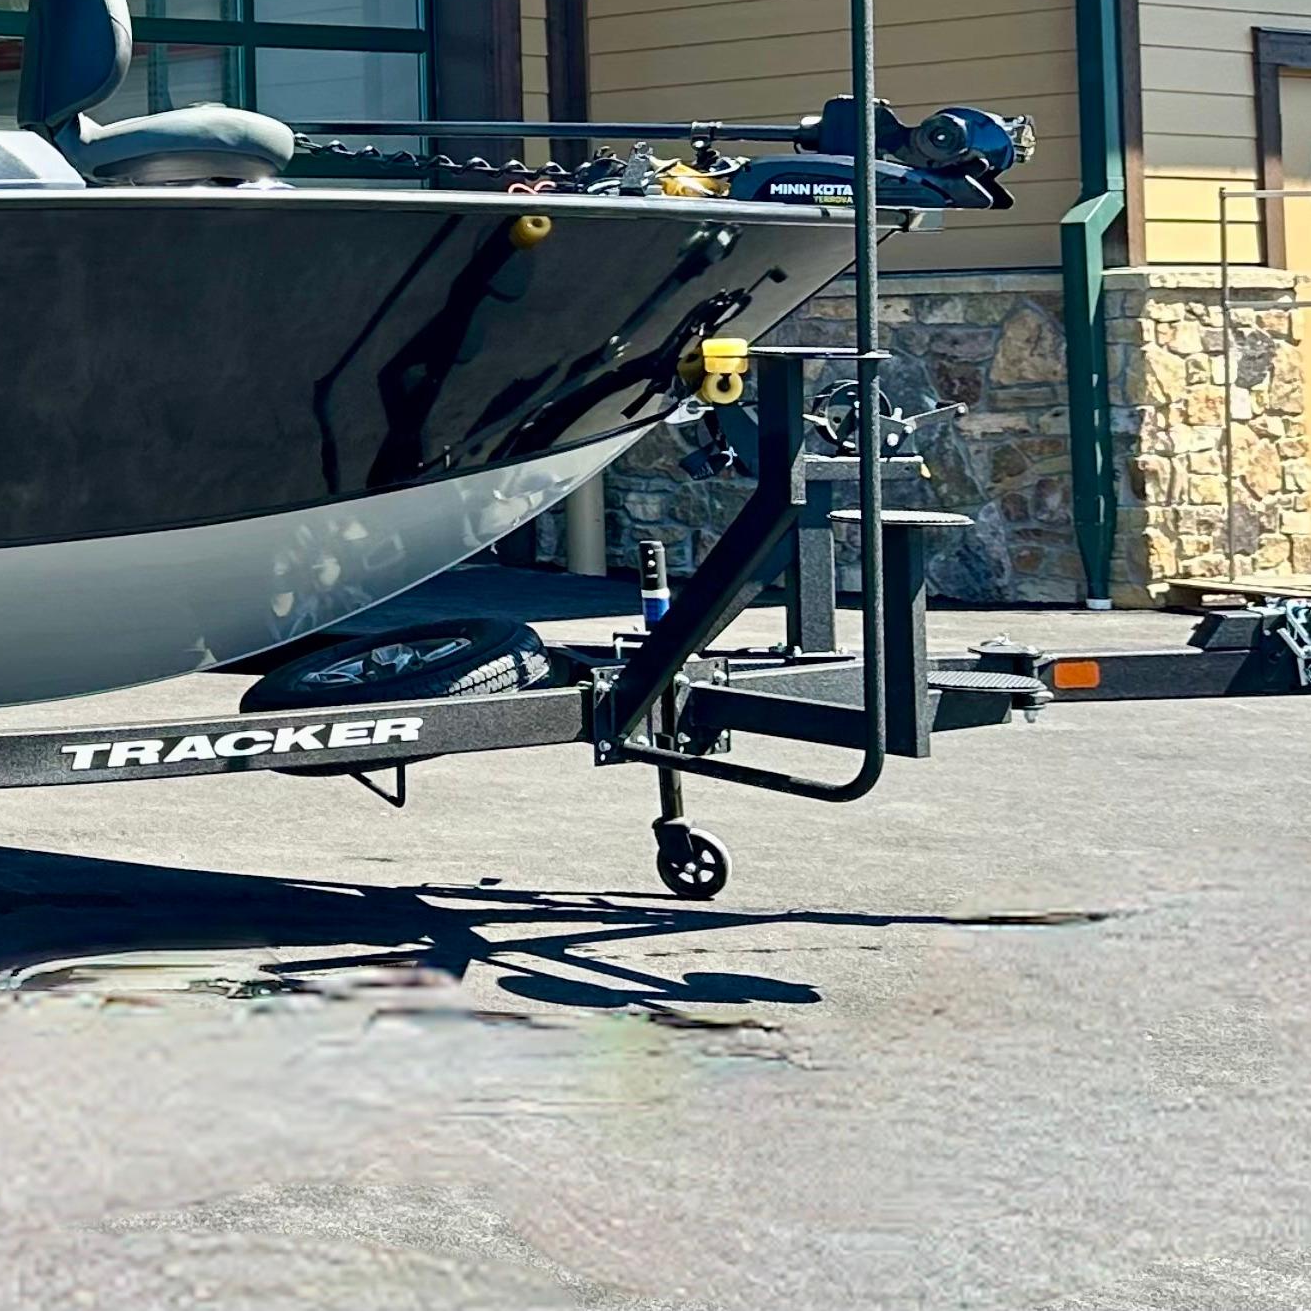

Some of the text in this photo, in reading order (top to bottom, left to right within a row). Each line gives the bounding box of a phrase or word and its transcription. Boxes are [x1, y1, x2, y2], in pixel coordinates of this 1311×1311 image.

[770, 183, 854, 195] MINN KOTA
[61, 717, 424, 770] TRACKER
